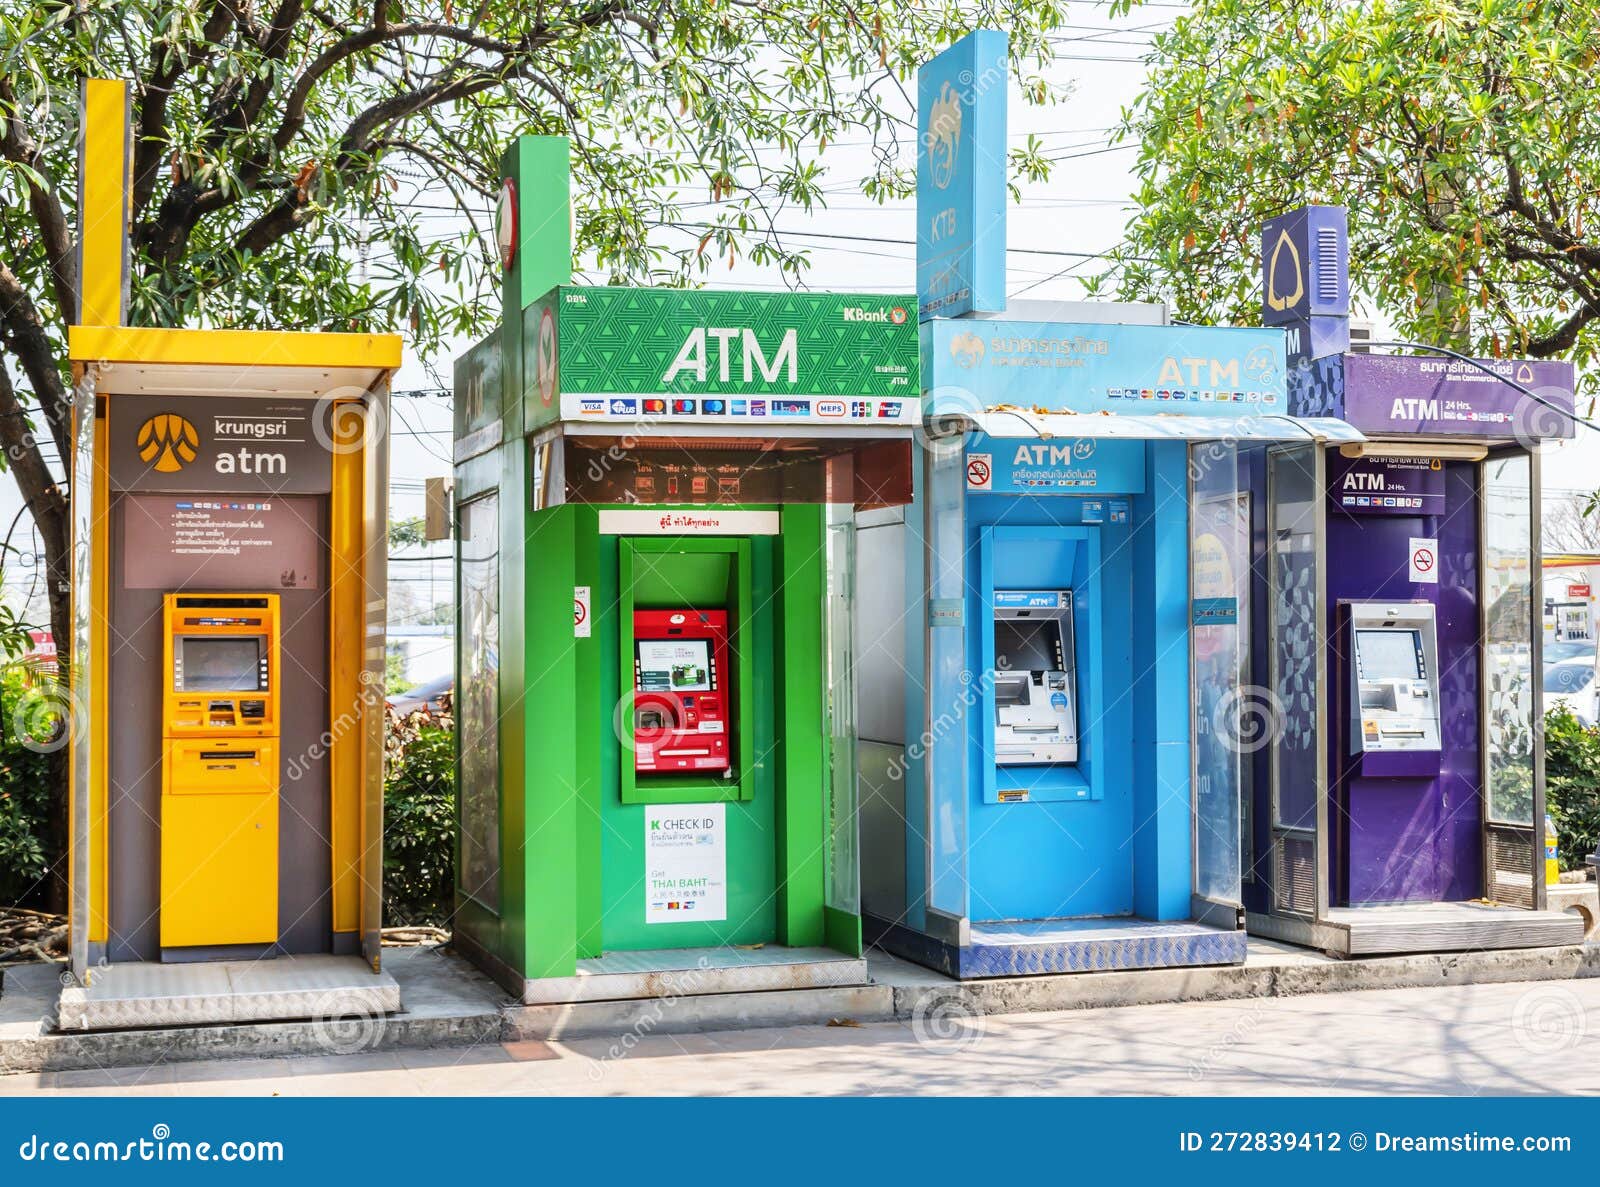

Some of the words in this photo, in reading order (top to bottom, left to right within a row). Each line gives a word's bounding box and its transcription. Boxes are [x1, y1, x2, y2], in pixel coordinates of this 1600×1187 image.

[931, 207, 956, 244] KTB
[843, 306, 888, 322] KBank
[662, 327, 798, 383] ATM
[1157, 356, 1239, 387] ATM
[1420, 359, 1513, 375] ธนาคารไทยพณิชย์
[1390, 398, 1438, 420] ATM
[1445, 400, 1455, 409] 24
[215, 419, 287, 438] krungsri
[215, 447, 287, 474] atm
[1013, 445, 1071, 466] ATM
[1343, 473, 1385, 490] ATM
[651, 820, 660, 830] K
[664, 819, 699, 830] CHECK
[703, 818, 714, 829] ID
[652, 880, 676, 889] THAI
[679, 878, 707, 888] BAHT
